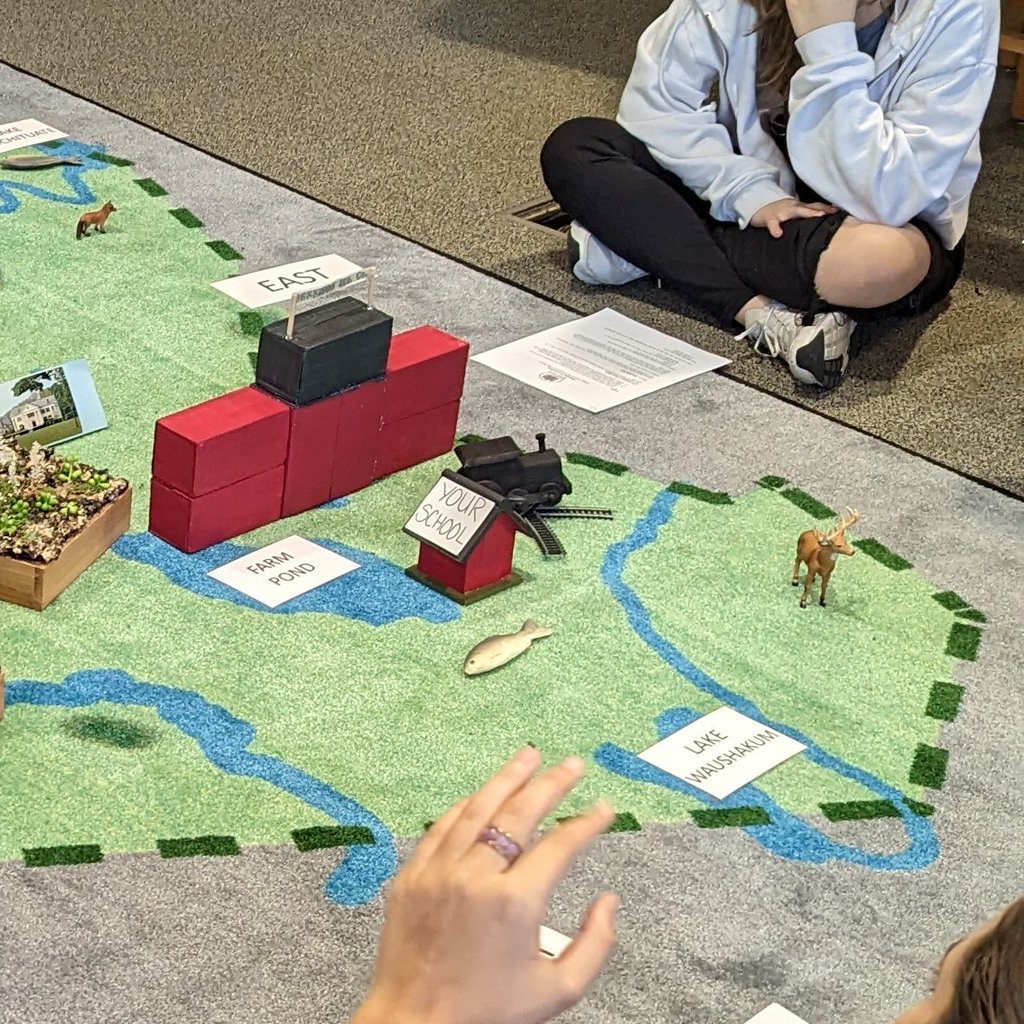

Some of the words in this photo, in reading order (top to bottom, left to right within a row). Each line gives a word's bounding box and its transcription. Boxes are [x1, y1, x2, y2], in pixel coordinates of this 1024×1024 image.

[257, 267, 330, 292] EAST
[438, 481, 487, 522] YOUR
[415, 503, 467, 545] SCHOOL
[246, 551, 294, 575] FARM
[268, 562, 316, 587] POND
[683, 729, 729, 755] LAKE
[684, 729, 779, 783] WAUSHAKUM
